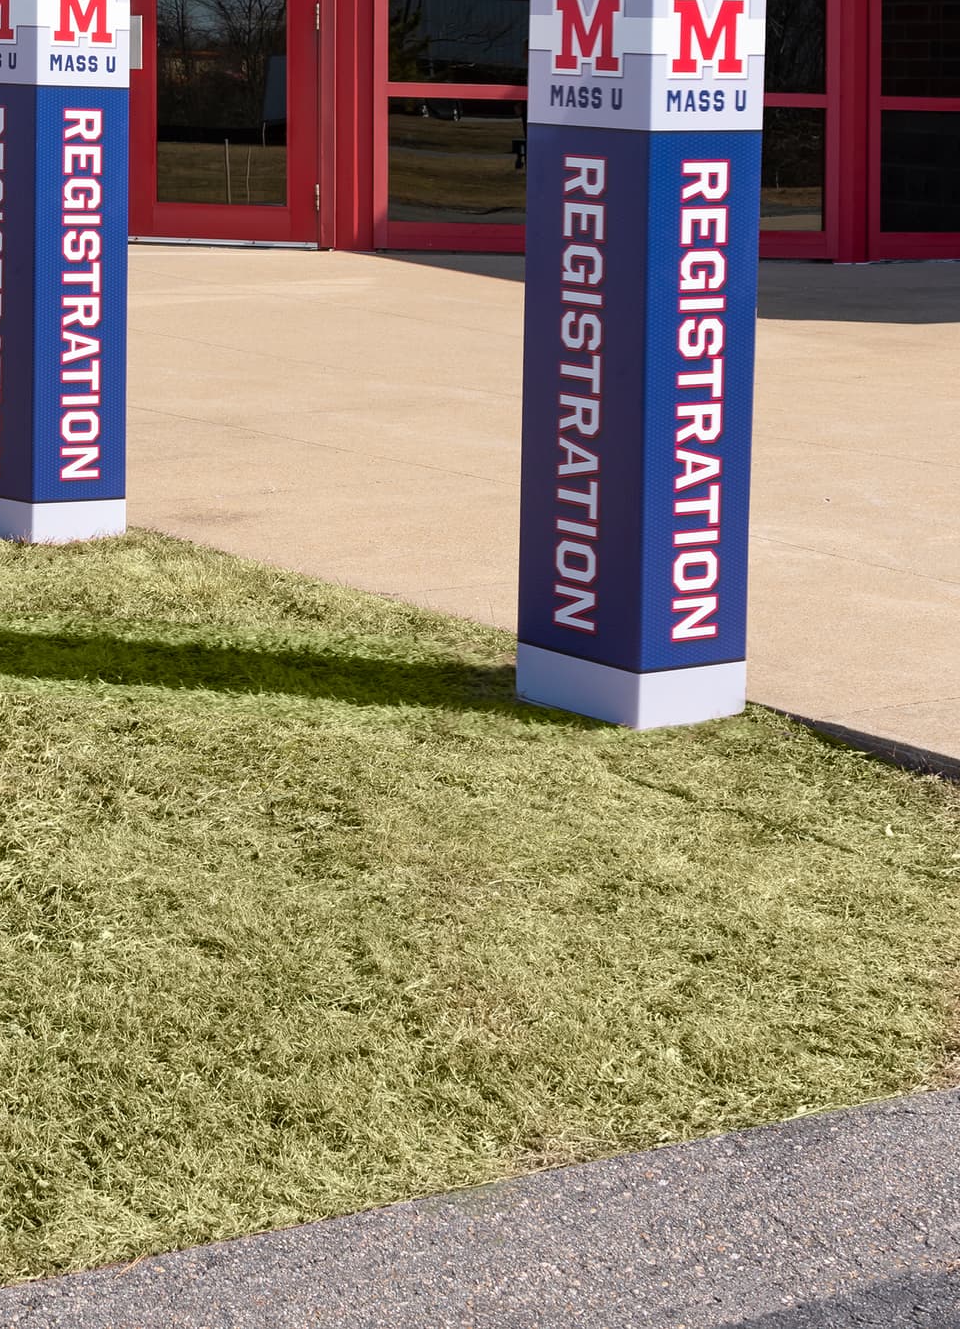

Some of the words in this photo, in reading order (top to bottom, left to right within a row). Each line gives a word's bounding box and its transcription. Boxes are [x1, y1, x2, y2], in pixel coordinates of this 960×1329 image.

[8, 52, 17, 70] U
[50, 54, 98, 72] MASS
[106, 56, 116, 73] U
[550, 85, 602, 110] MASS
[611, 88, 623, 111] U
[666, 90, 725, 112] MASS
[735, 90, 747, 112] U
[60, 106, 103, 482] REGISTRATION
[552, 154, 607, 635] REGISTRATION
[670, 158, 731, 643] REGISTRATION
